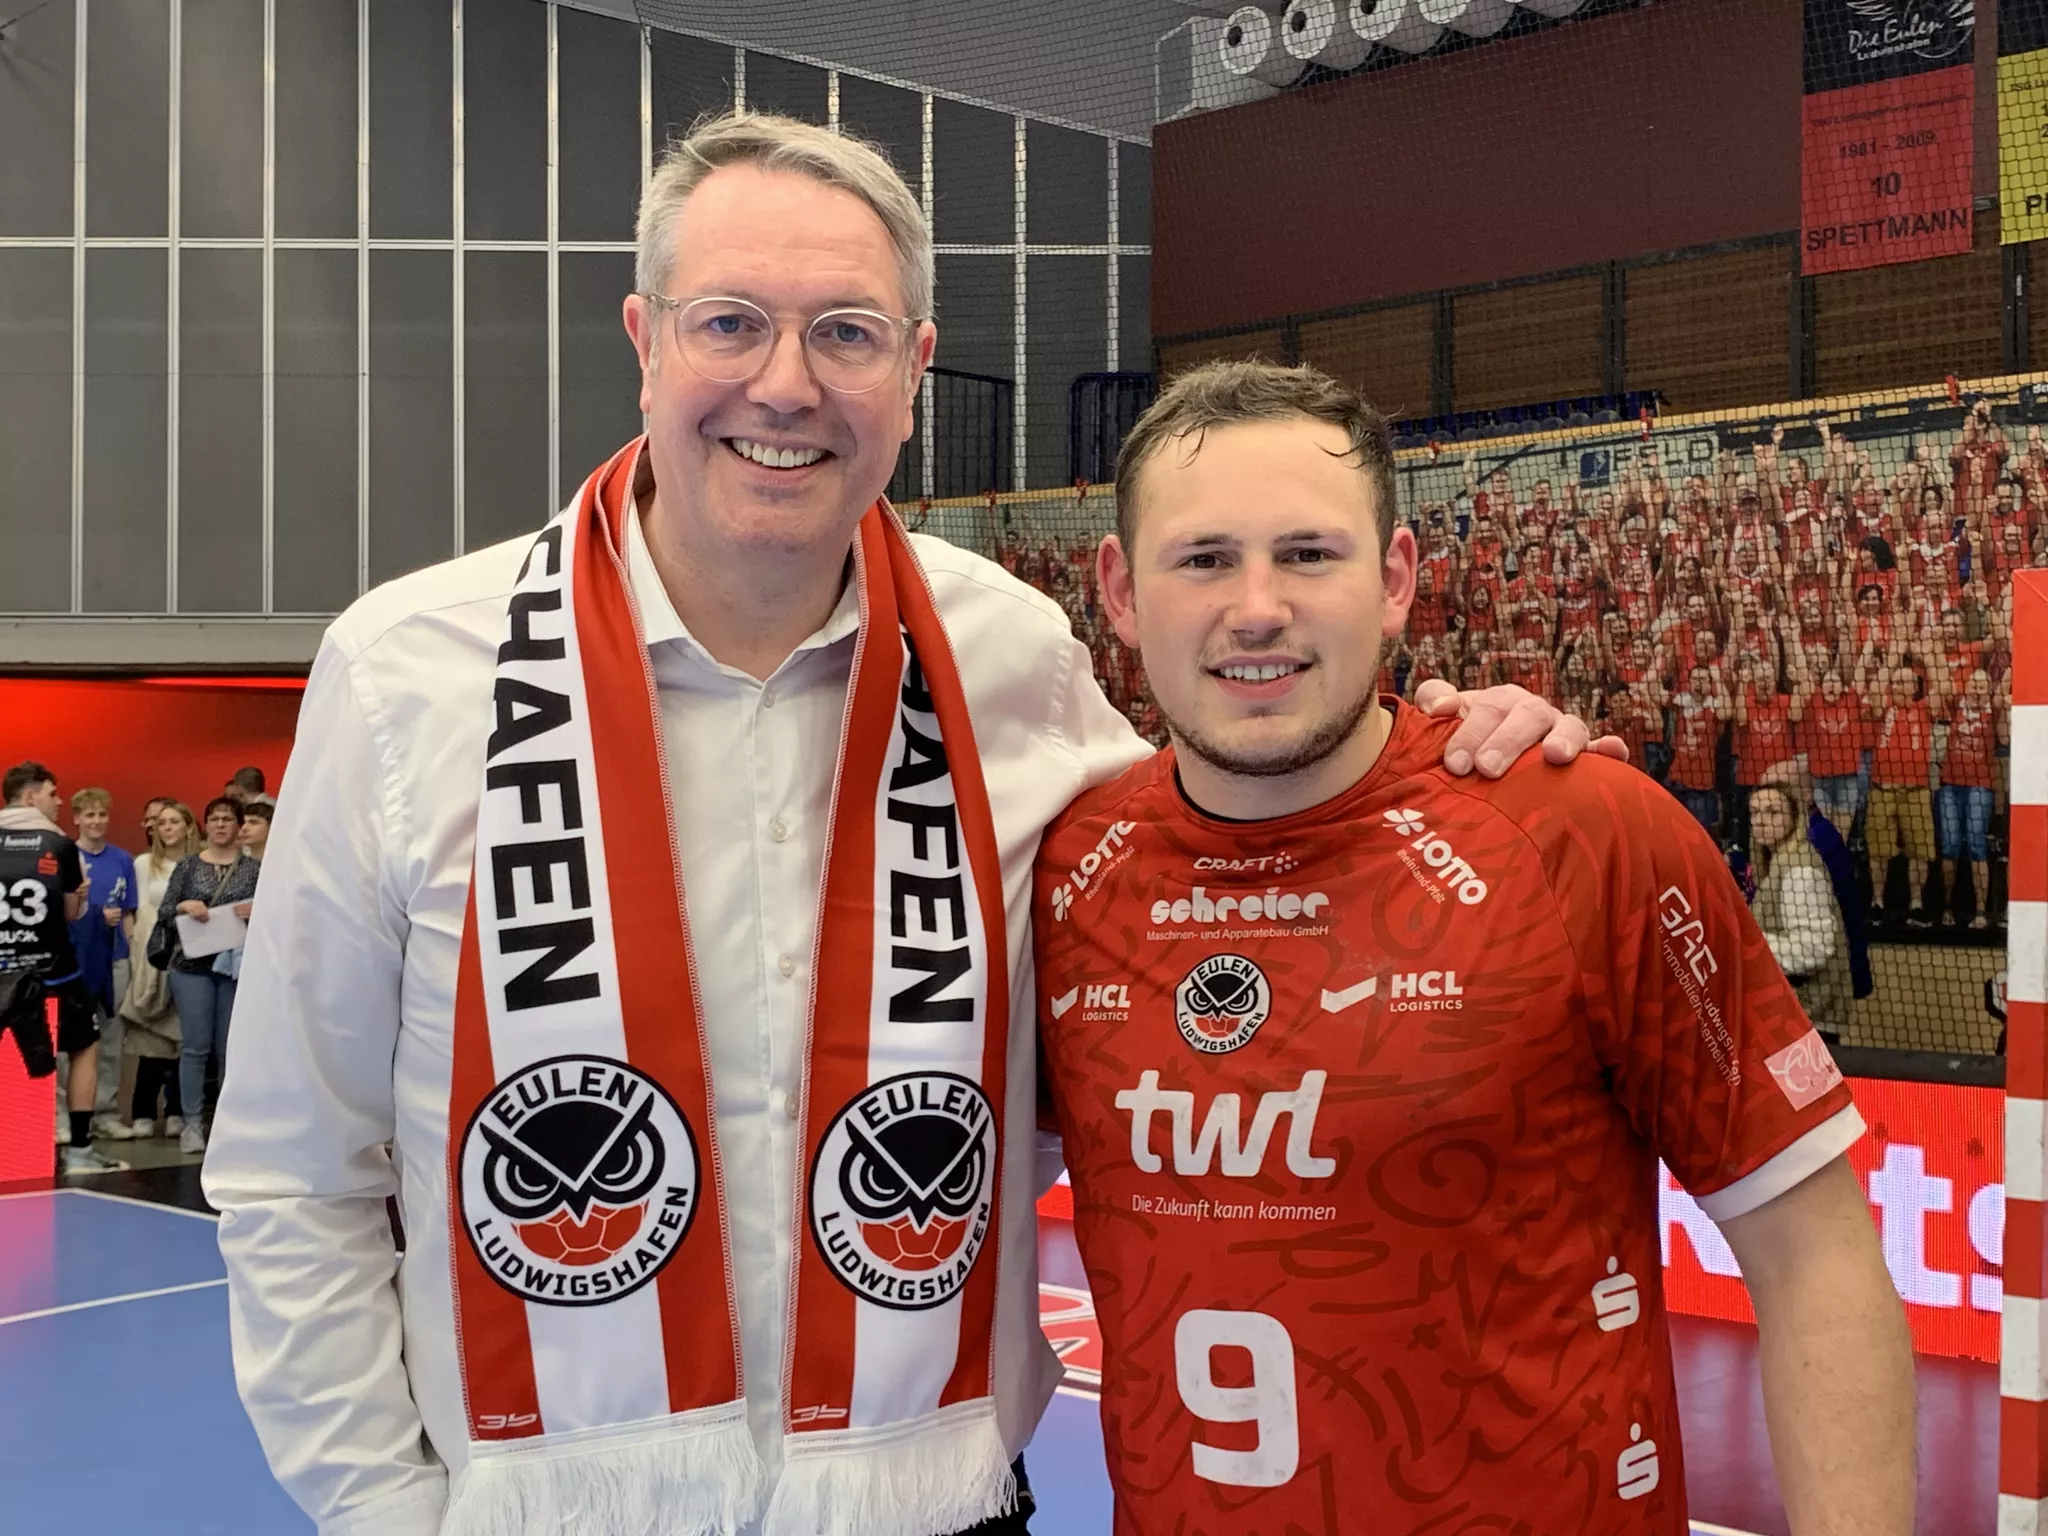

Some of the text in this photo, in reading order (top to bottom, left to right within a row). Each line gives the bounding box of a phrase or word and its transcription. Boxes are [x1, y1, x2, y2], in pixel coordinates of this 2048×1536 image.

[1895, 130, 1936, 149] 2009
[1871, 172, 1901, 197] 10
[1806, 208, 1968, 251] SPETTMANN
[1084, 844, 1136, 902] Rheinland-Pfalz
[1193, 855, 1275, 872] CRAFT
[1410, 831, 1488, 905] LOTTO
[1150, 886, 1330, 925] schreier
[1146, 925, 1329, 942] Maschinen- und Apparatebau GmbH
[1196, 957, 1255, 981] EULEN
[1391, 970, 1464, 998] HCL
[1083, 983, 1132, 1009] HCL
[1389, 999, 1463, 1013] LOGISTICS
[1082, 1011, 1129, 1021] LOGISTICS
[1179, 1011, 1265, 1051] LUDWIGSHAFEN
[490, 1067, 639, 1130] EULEN
[860, 1081, 984, 1131] EULEN
[1115, 1069, 1337, 1179] twl
[1132, 1194, 1336, 1222] Die Zukunft kann kommen
[474, 1186, 689, 1297] LUDWIGSHAFEN
[820, 1202, 990, 1301] LUDWIGSHAFEN
[1174, 1308, 1300, 1488] 9
